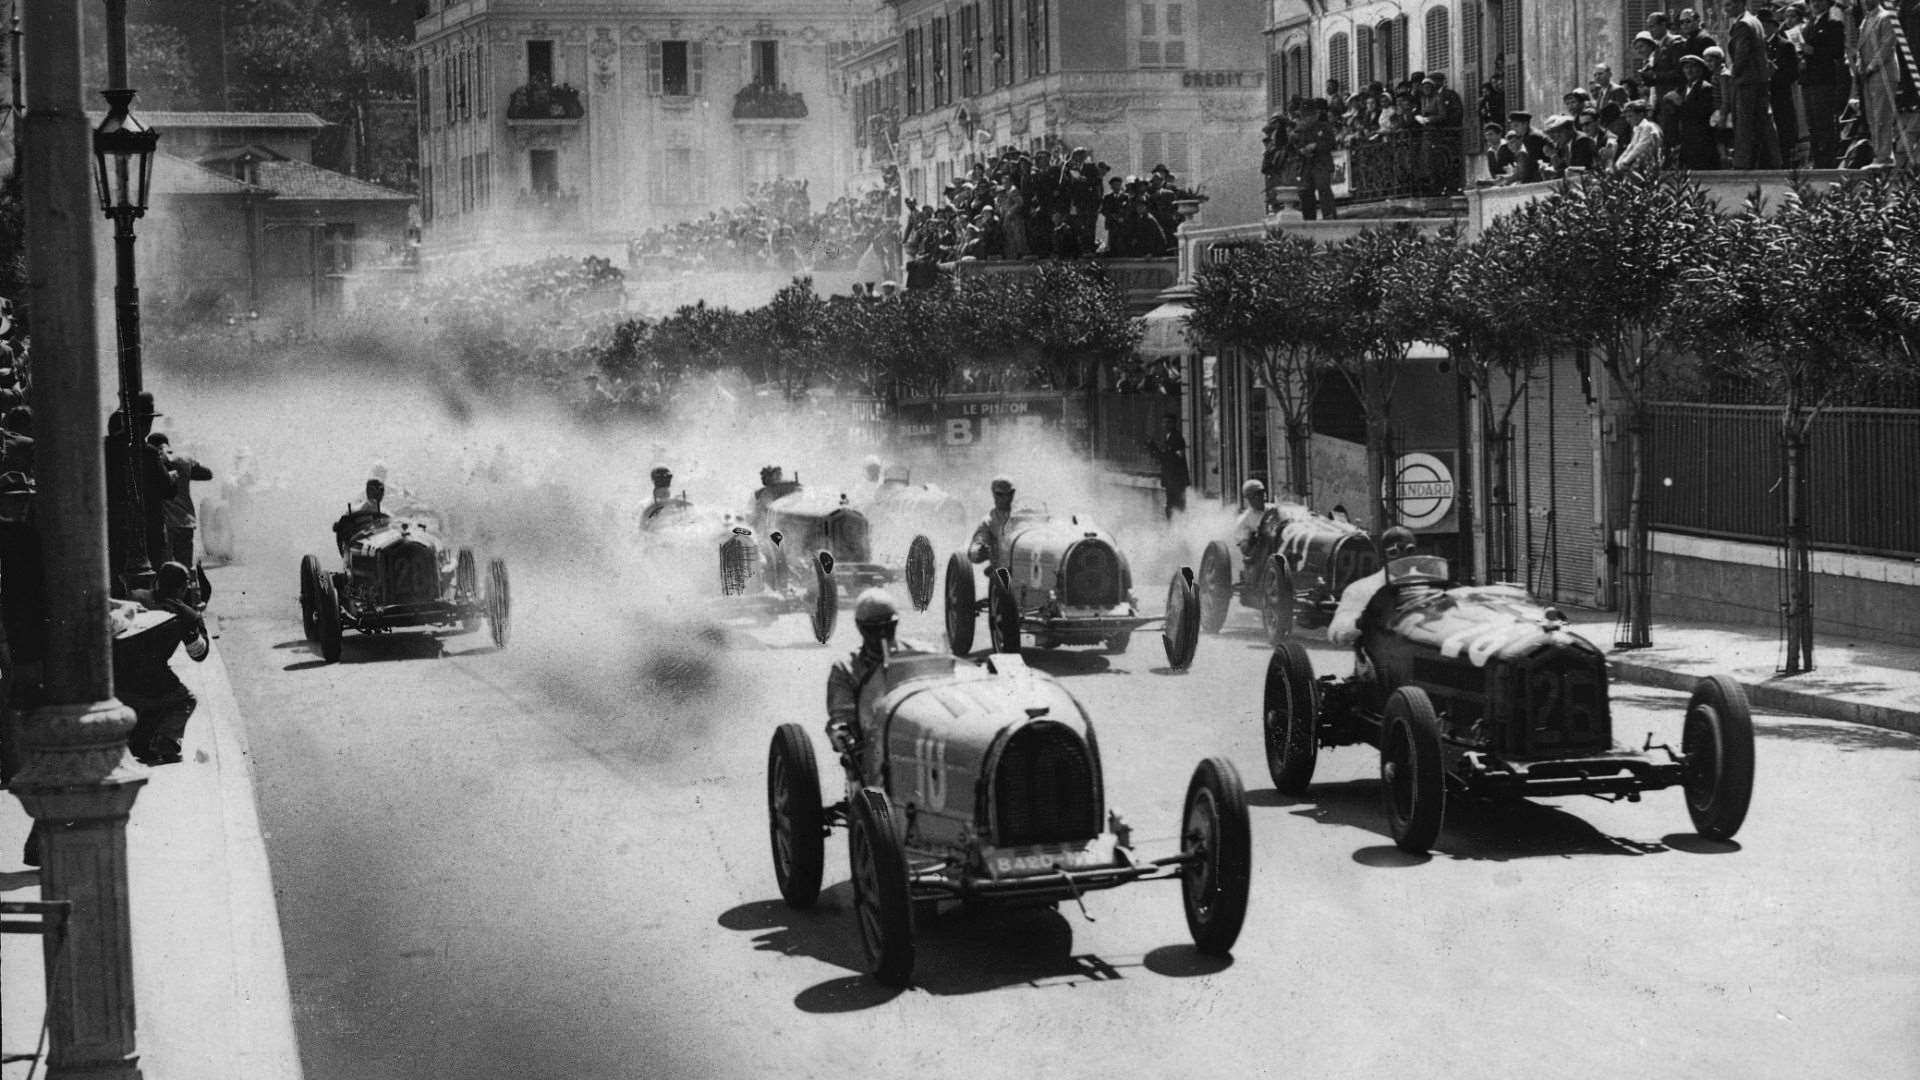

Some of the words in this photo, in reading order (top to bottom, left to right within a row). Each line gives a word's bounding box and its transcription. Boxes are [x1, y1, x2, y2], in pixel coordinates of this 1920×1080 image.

[963, 404, 978, 416] LE
[1533, 669, 1600, 743] 26
[915, 737, 947, 812] 18
